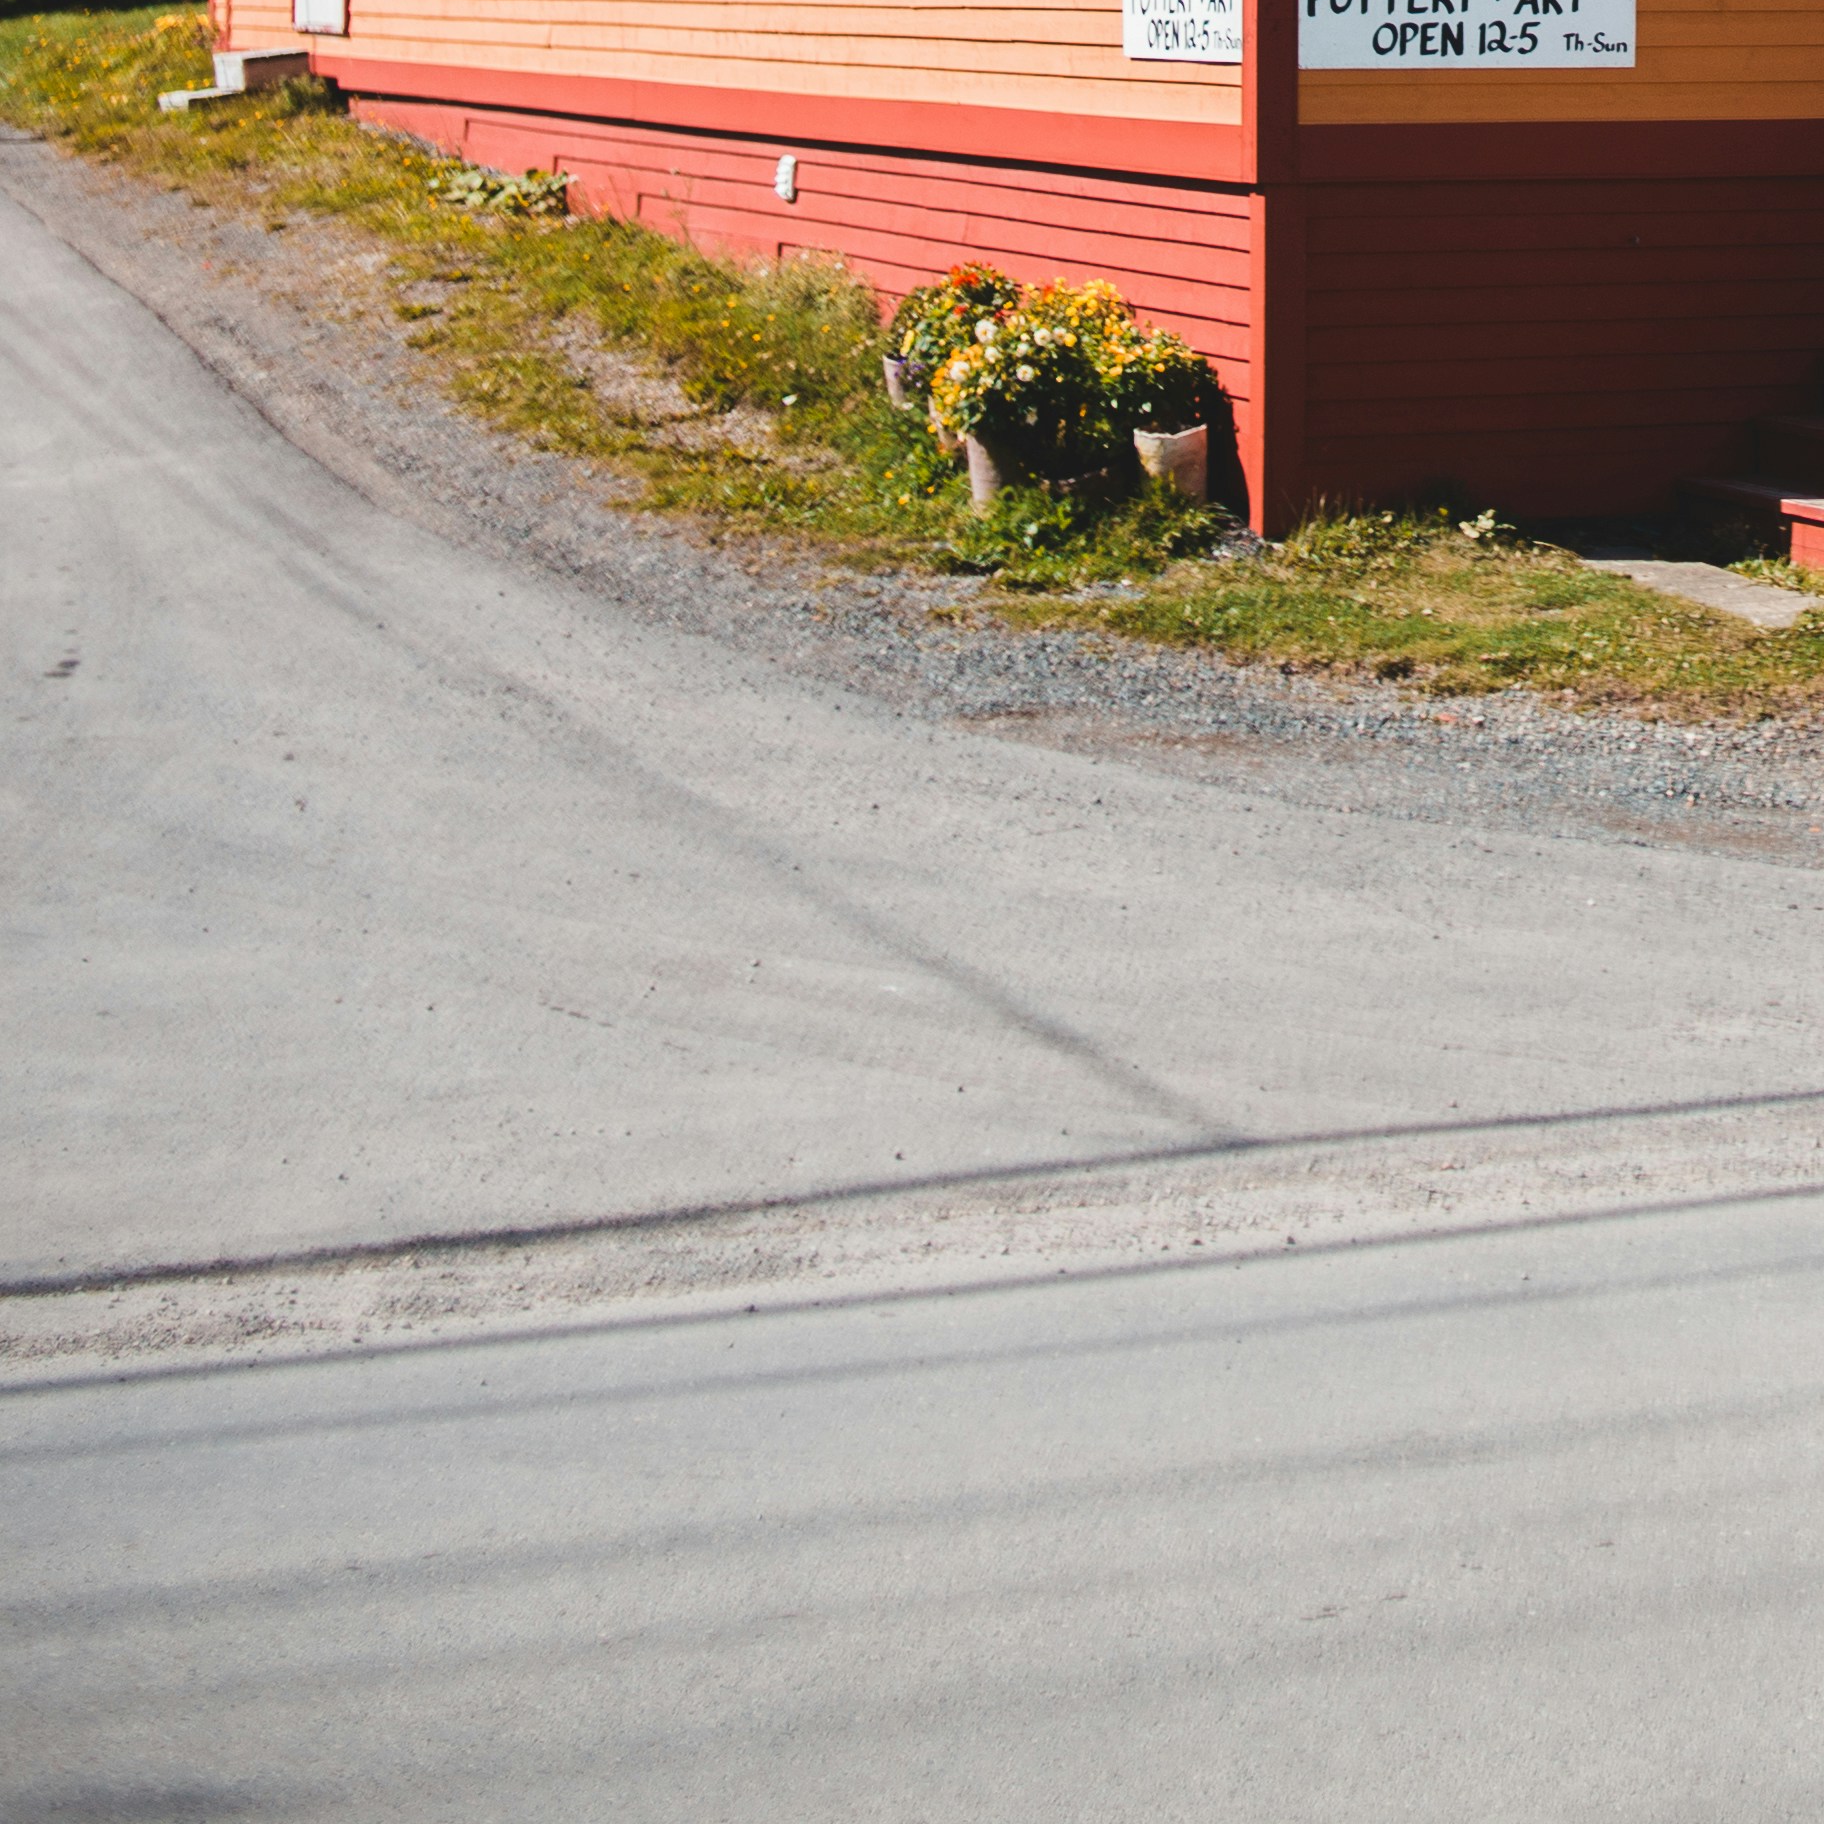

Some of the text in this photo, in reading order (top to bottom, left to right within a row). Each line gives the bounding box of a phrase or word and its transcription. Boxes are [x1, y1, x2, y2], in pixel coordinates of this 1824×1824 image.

[1147, 19, 1180, 50] OPEN
[1184, 18, 1210, 51] 12-5
[1372, 20, 1628, 57] OPEN 12-5 Th-Sun
